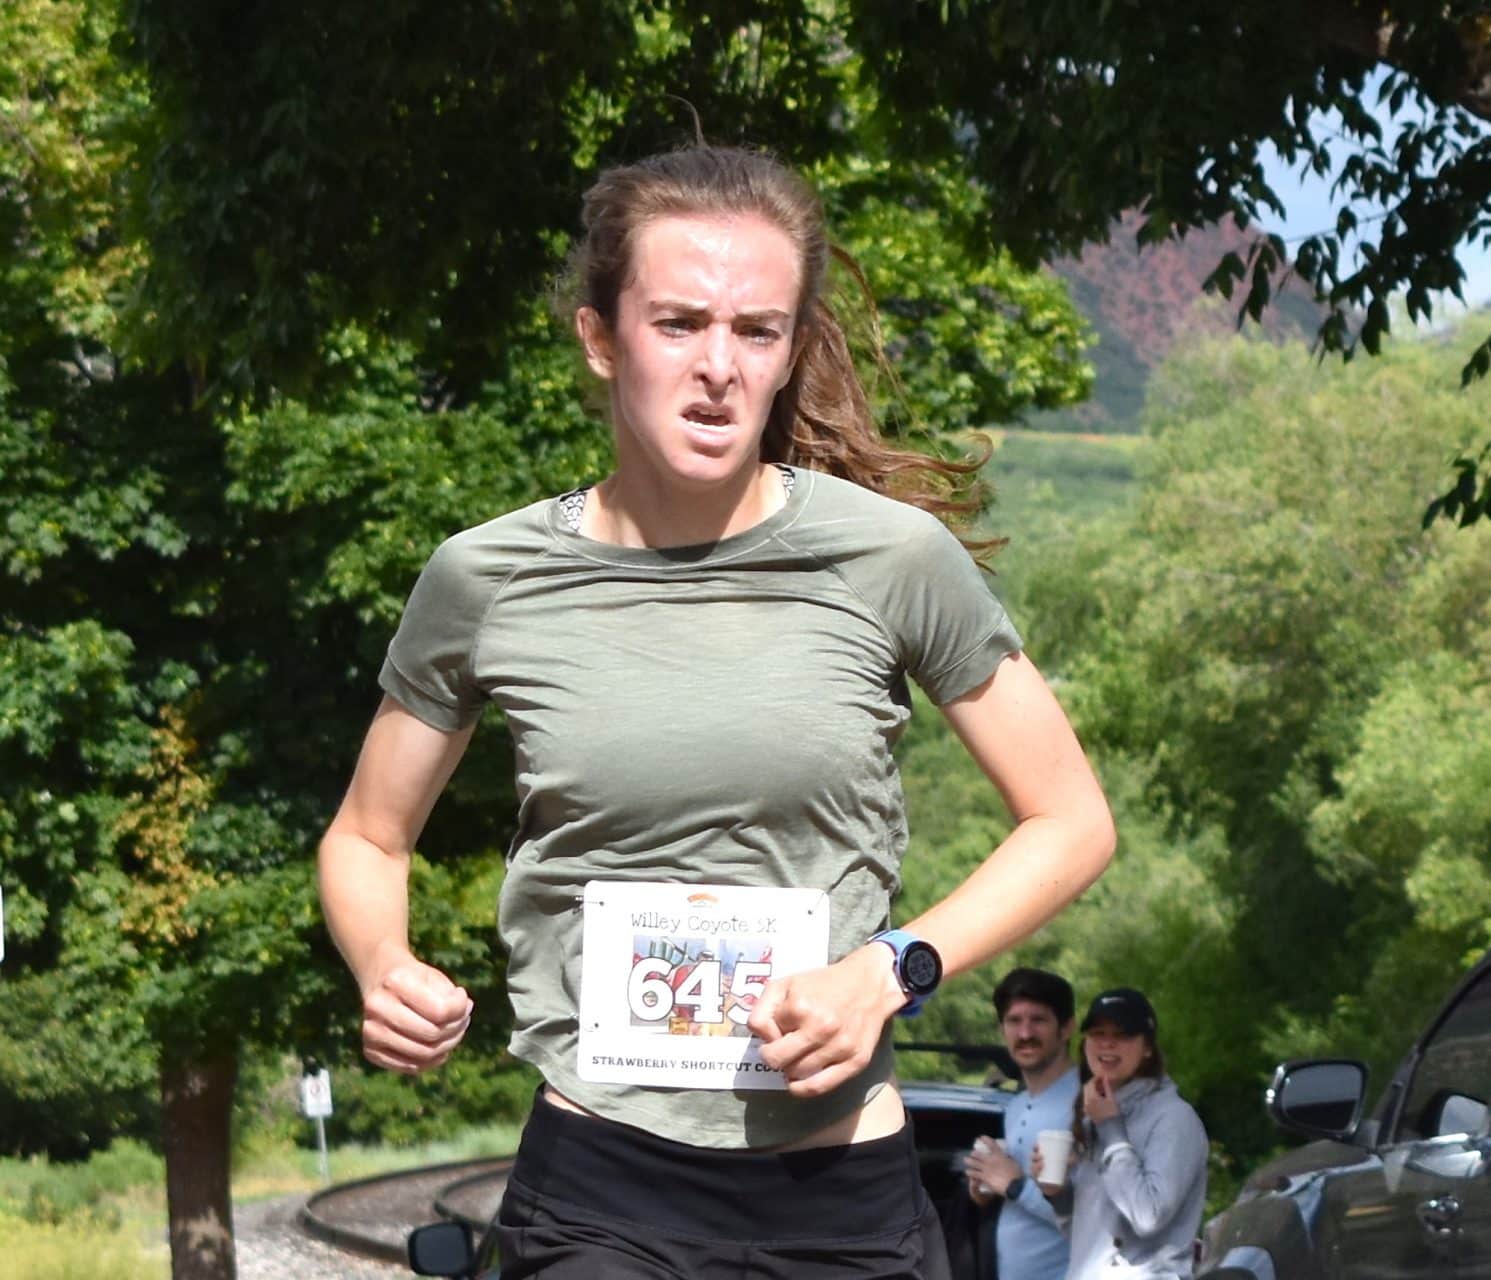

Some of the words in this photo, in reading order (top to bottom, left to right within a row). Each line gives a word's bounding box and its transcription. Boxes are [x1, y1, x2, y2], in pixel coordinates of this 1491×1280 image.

[631, 912, 681, 933] Willey
[688, 915, 749, 935] Coyote
[627, 956, 772, 1025] 645
[592, 1056, 676, 1069] STRAWBERRY
[681, 1060, 752, 1072] SHORTCUT
